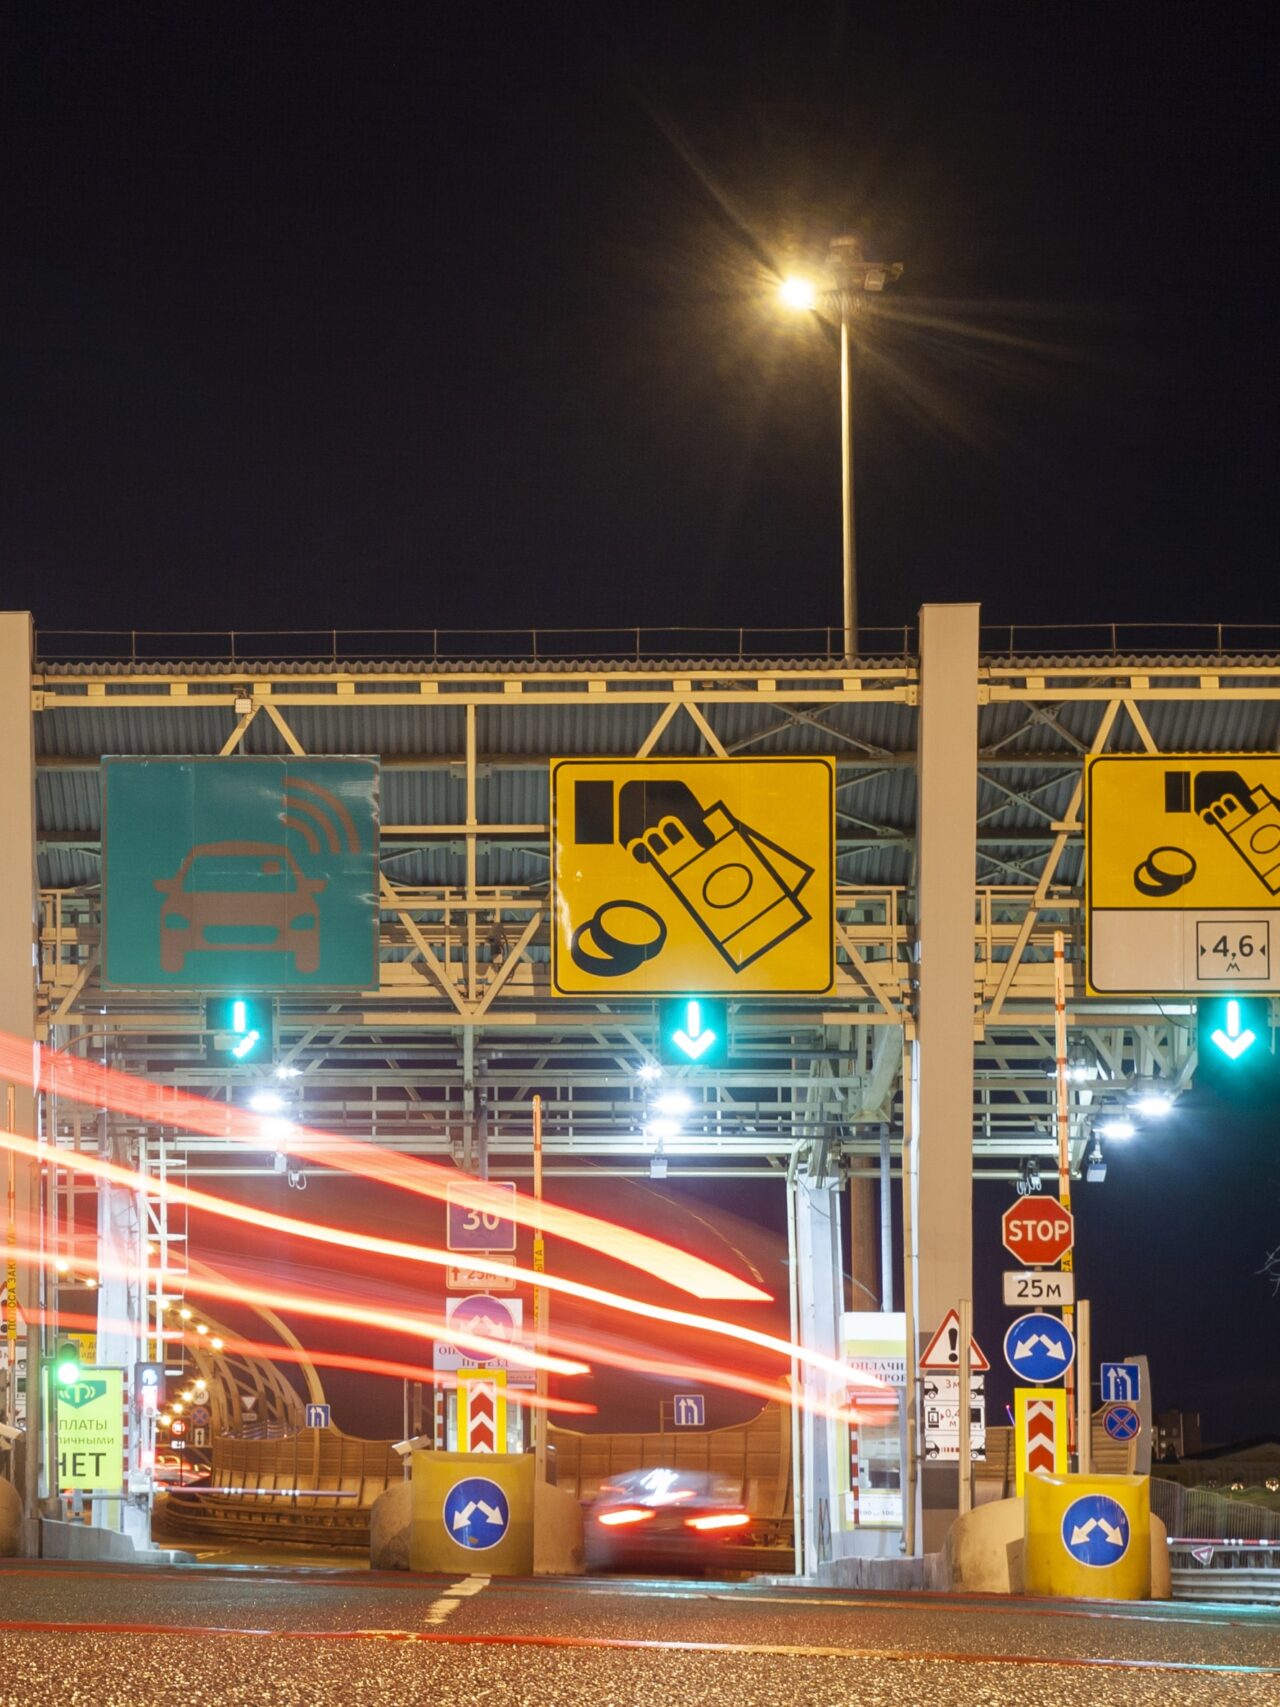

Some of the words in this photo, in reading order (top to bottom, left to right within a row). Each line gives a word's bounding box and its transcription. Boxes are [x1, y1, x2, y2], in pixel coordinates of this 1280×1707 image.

[1212, 935, 1254, 960] 4,6
[463, 1206, 500, 1231] 30
[1008, 1219, 1070, 1242] STOP
[7, 1232, 17, 1283] ЗАКТА
[1016, 1279, 1062, 1298] 25м
[851, 1361, 905, 1371] ОПЛАЧИ
[59, 1419, 107, 1431] ПЛАТЫ
[58, 1436, 114, 1445] ичными
[58, 1452, 107, 1477] НЕТ
